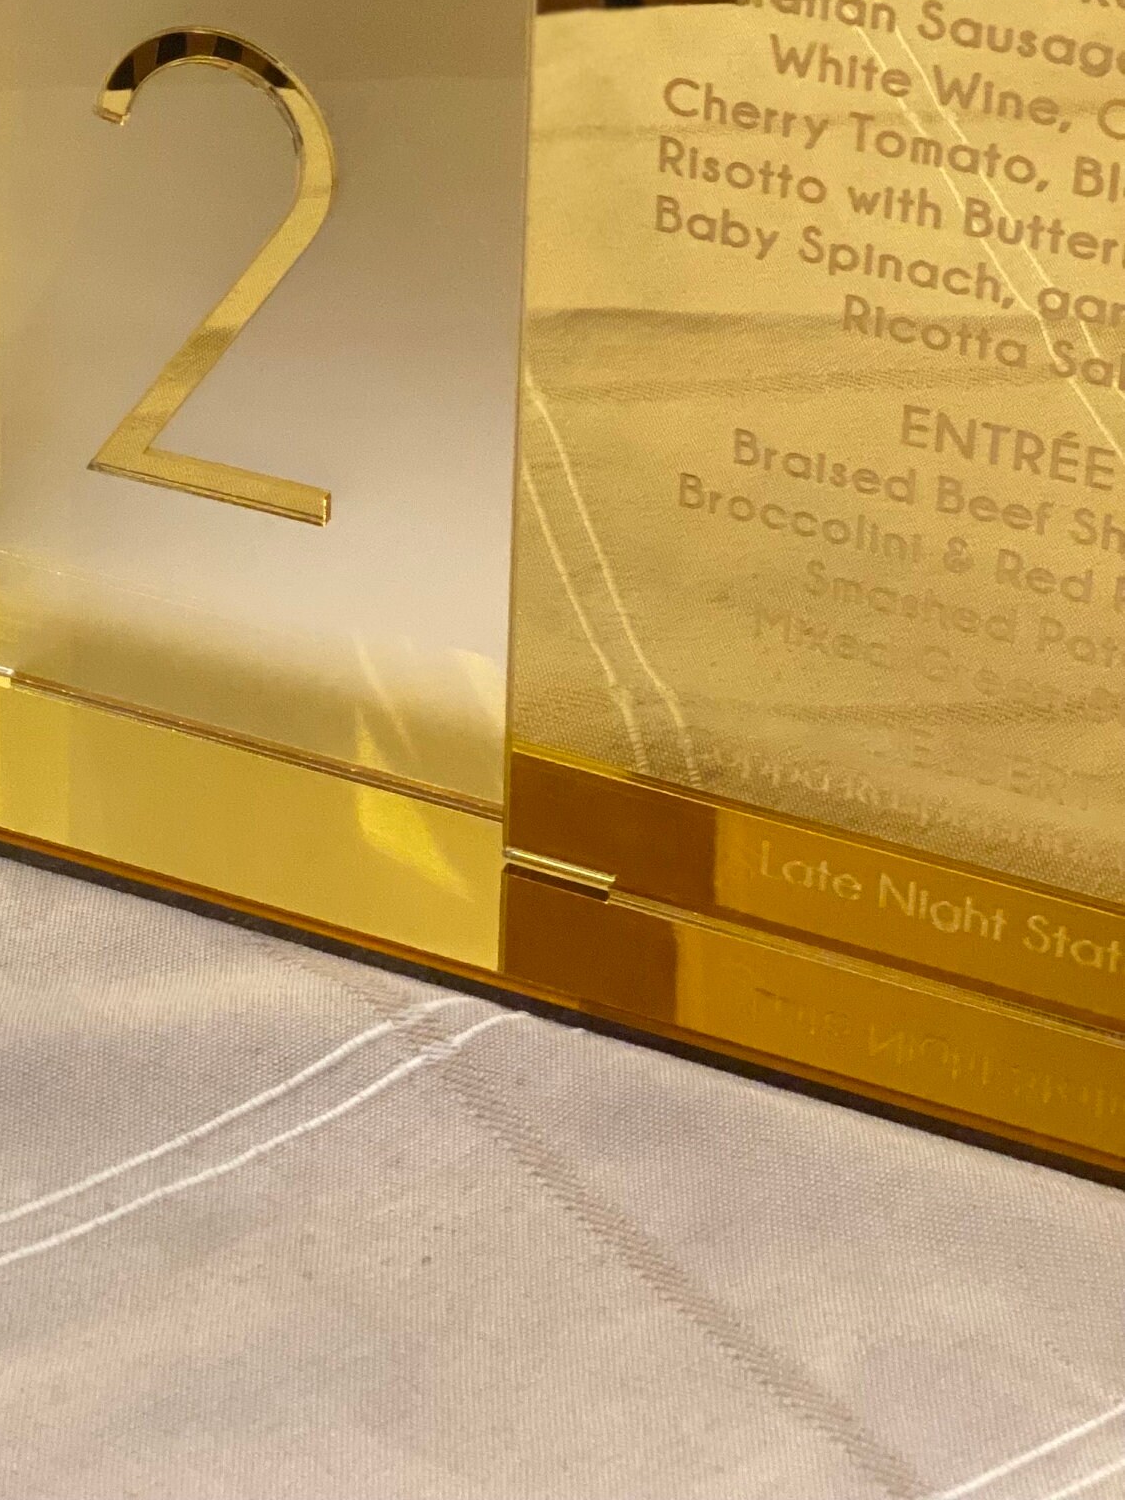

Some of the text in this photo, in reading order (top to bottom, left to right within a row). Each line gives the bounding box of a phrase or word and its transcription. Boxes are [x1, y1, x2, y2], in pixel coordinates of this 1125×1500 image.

[770, 33, 912, 97] White
[934, 64, 1072, 134] Wine,
[917, 0, 1125, 78] Sausag
[663, 77, 829, 150] Cherry
[850, 111, 1049, 192] Tomato,
[1072, 156, 1125, 203] Bl
[655, 195, 779, 260] Baby
[799, 225, 1016, 309] Spinach,
[659, 135, 1125, 267] Risotto with Butter
[87, 25, 338, 527] 2
[843, 294, 1027, 369] Ricotta
[733, 428, 917, 506] Braised
[937, 474, 1053, 535] Beef
[901, 404, 1115, 492] ENTRÉE
[678, 472, 922, 563] Broccolini
[943, 537, 971, 574] &
[995, 548, 1094, 602] Red
[1038, 616, 1125, 669] Pot
[759, 840, 1125, 973] Late Night Stat
